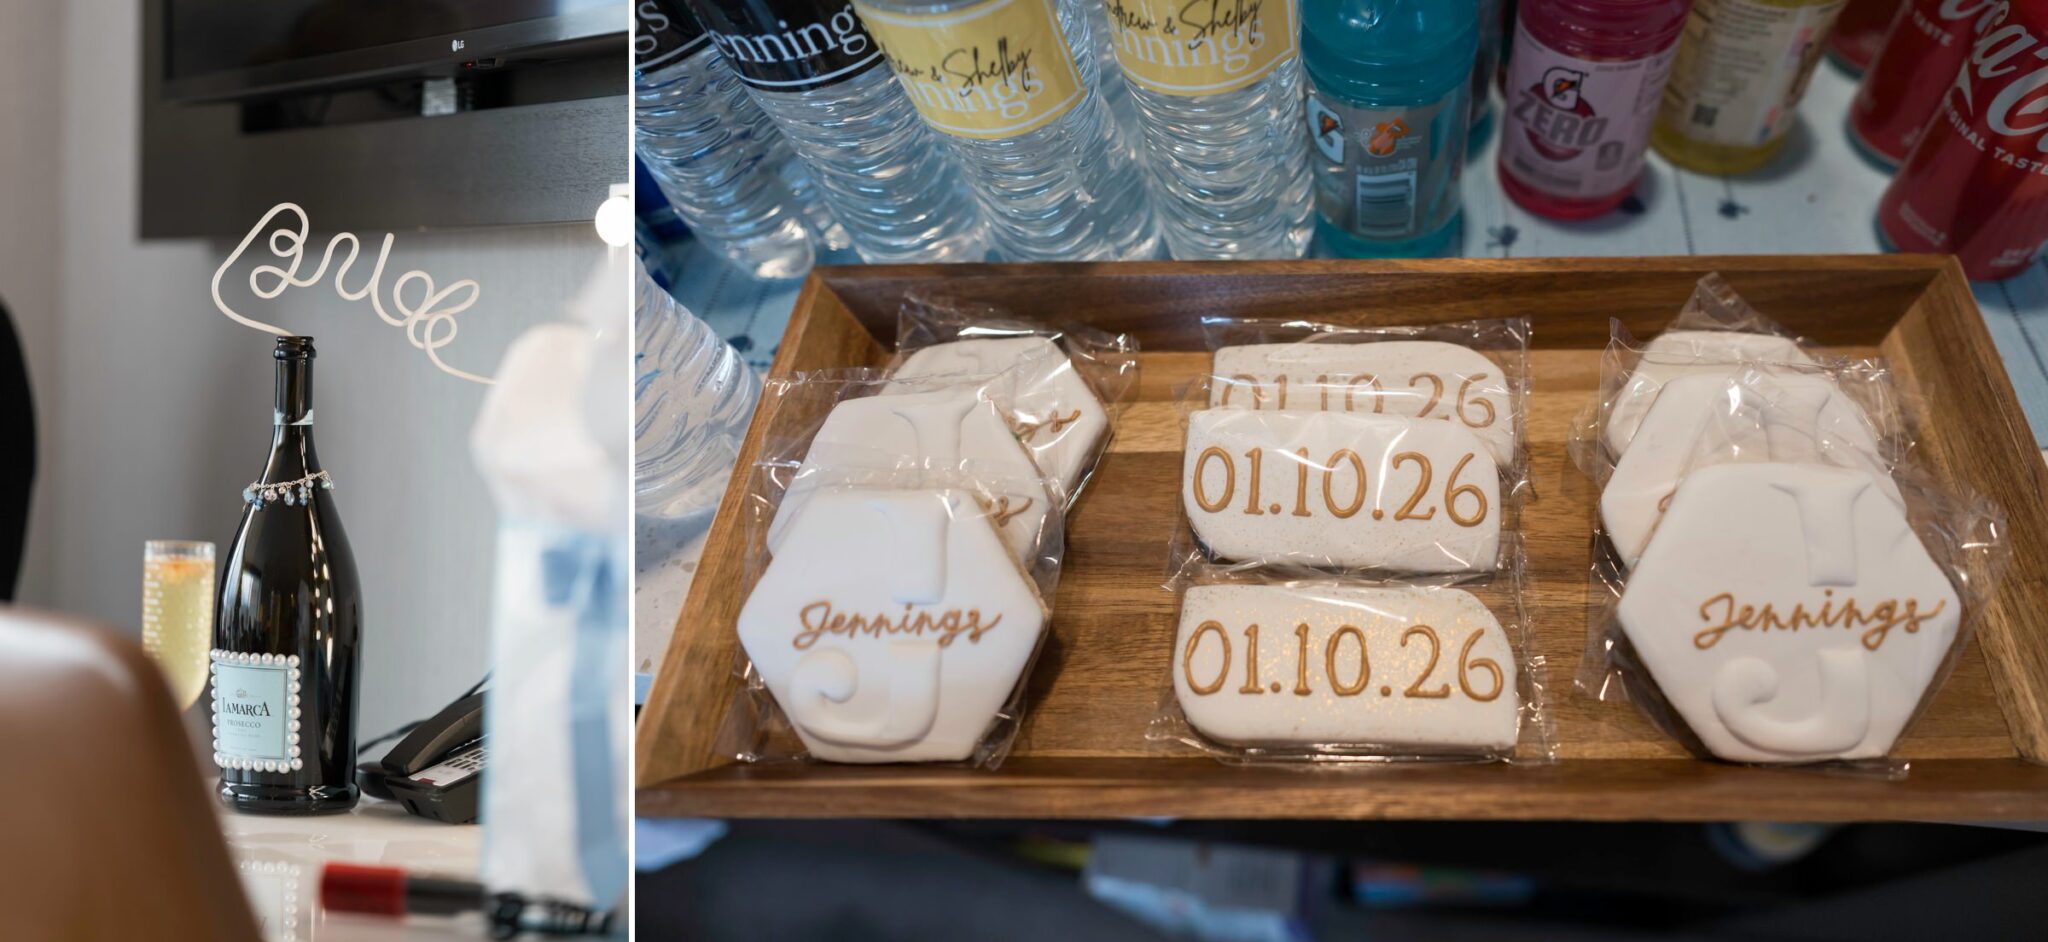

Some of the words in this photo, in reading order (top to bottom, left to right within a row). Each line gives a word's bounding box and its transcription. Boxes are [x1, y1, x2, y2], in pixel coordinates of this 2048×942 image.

[709, 5, 869, 62] enning
[942, 37, 1032, 97] Shelby
[1512, 90, 1609, 148] ZERO
[1994, 146, 2048, 176] TASTE
[1193, 446, 1489, 527] 01.10.26
[793, 600, 1002, 649] Jennings
[1693, 589, 1946, 651] Jennings
[1183, 619, 1504, 702] 01.10.26
